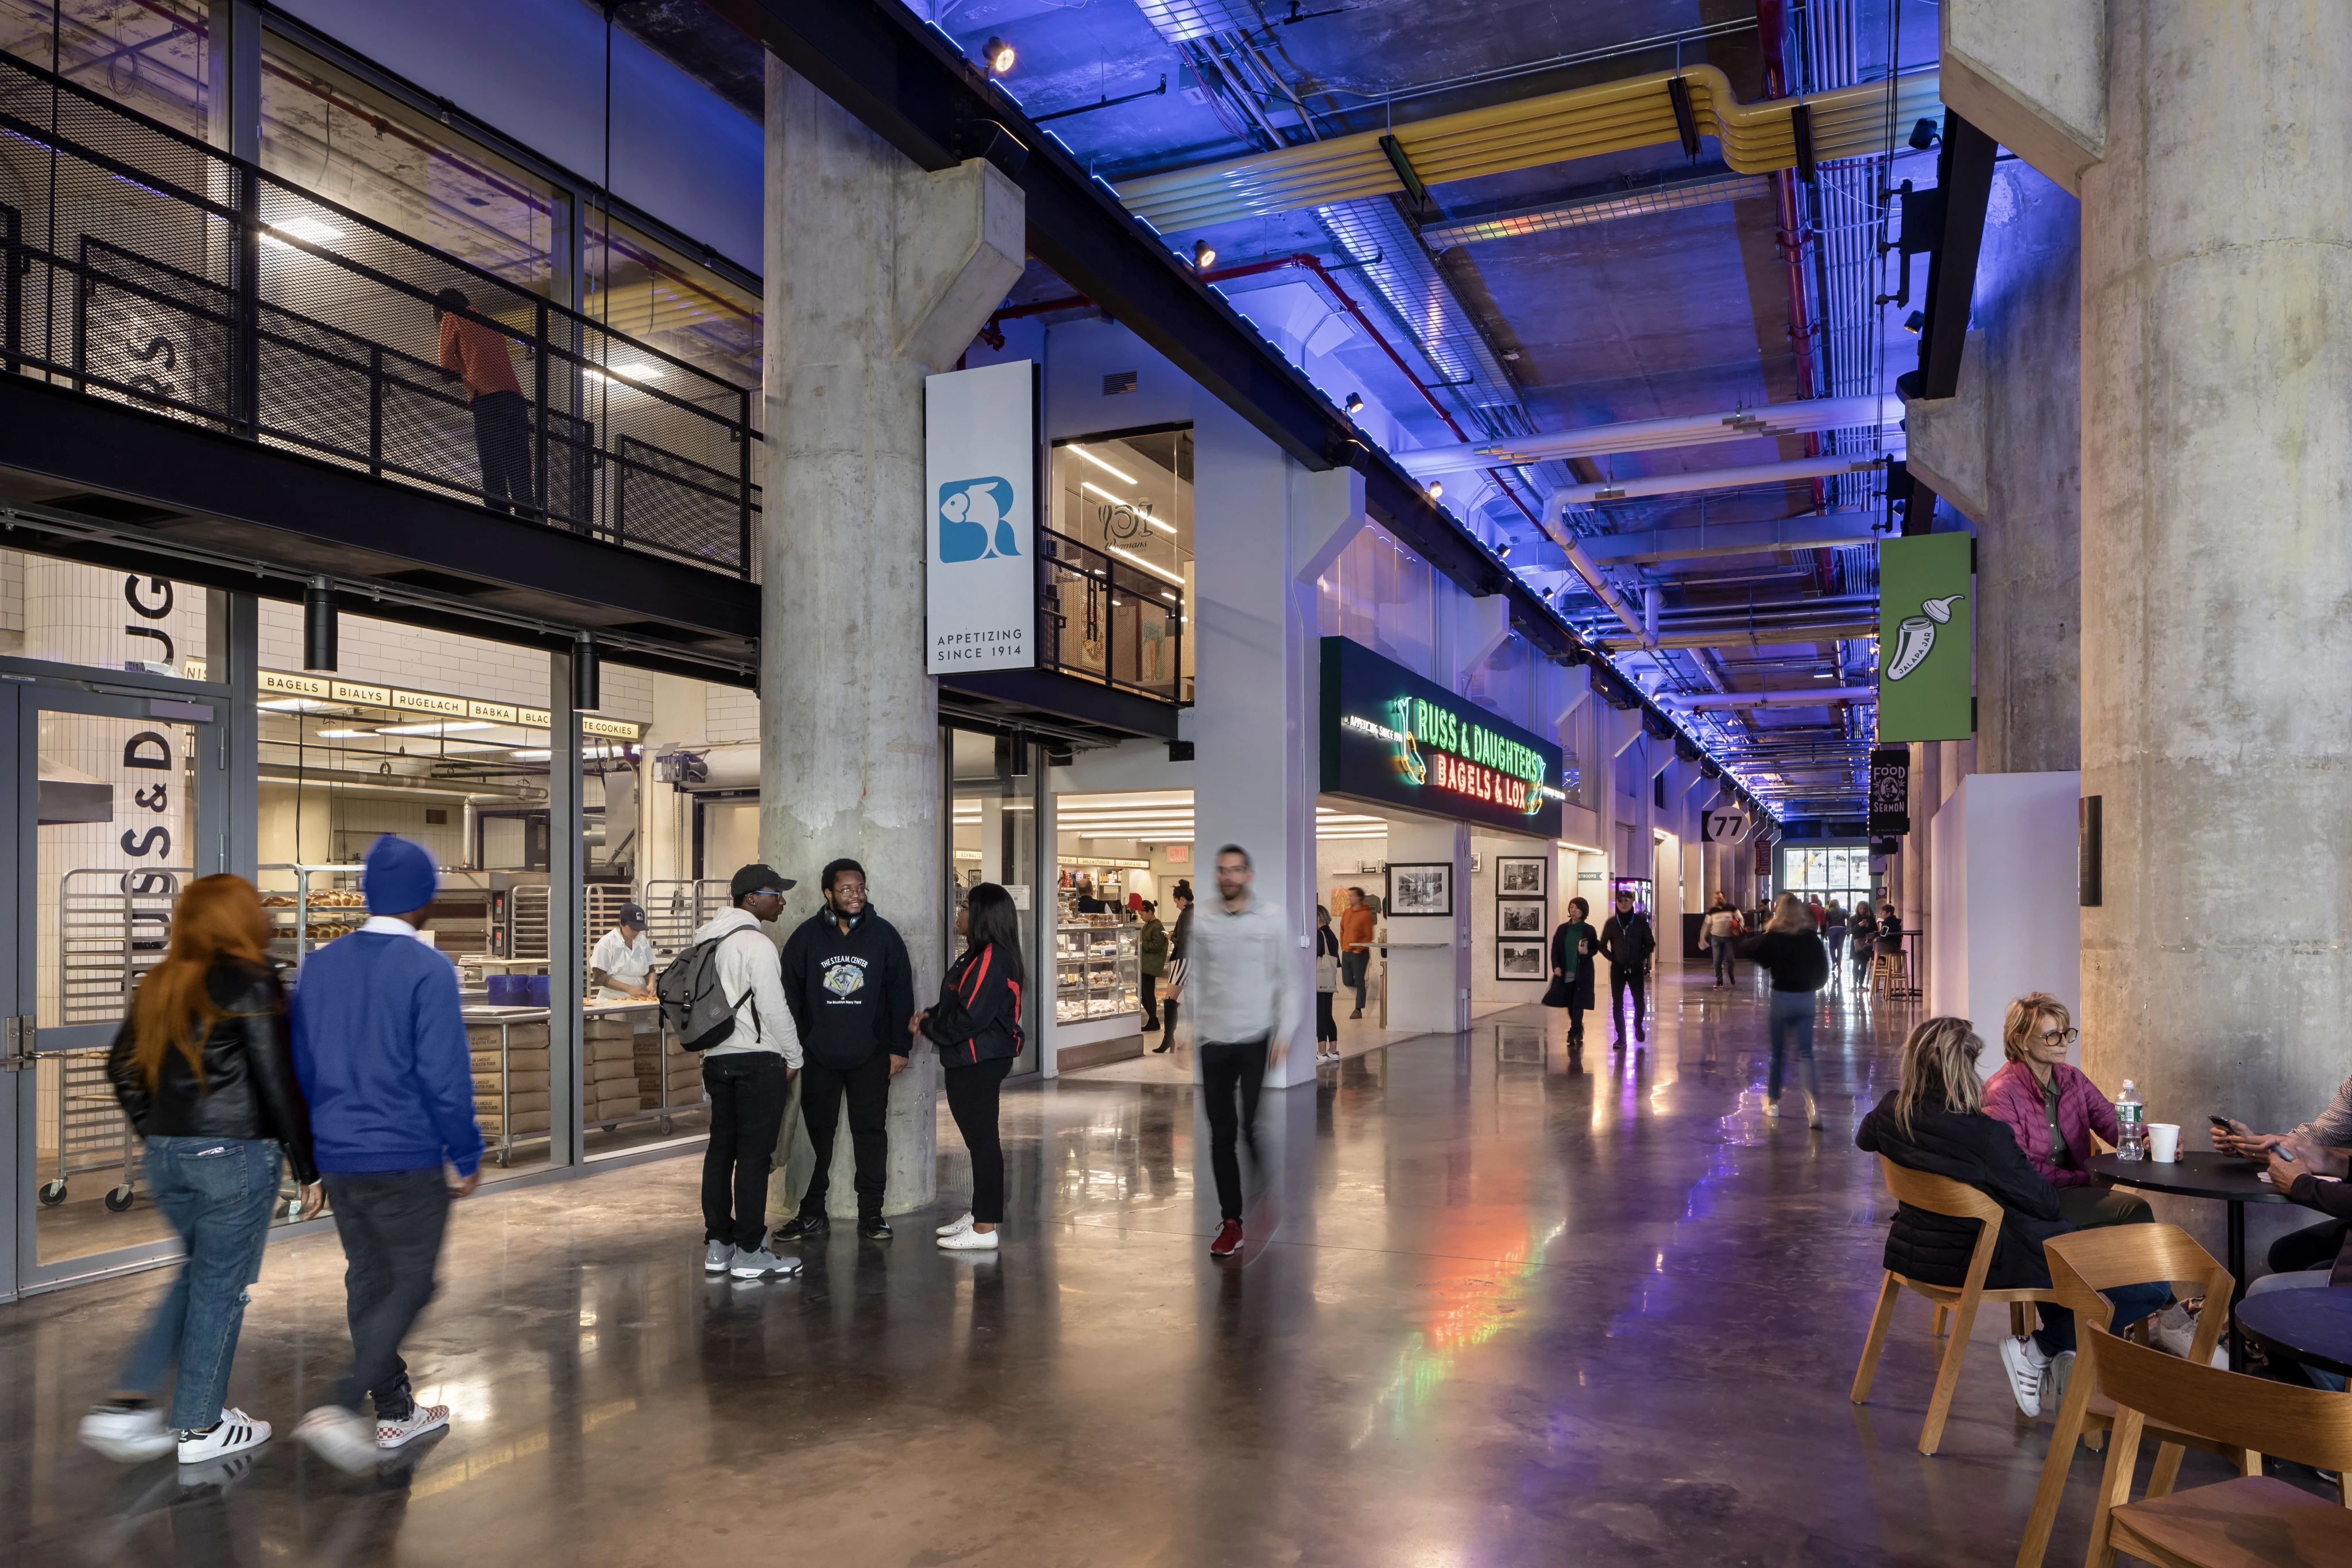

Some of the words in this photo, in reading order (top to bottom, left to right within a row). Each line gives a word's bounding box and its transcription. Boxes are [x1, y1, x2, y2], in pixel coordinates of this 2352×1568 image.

[1103, 538, 1147, 555] Wegmans
[938, 629, 1022, 645] APPETIZING
[938, 648, 981, 660] SINCE
[992, 645, 1021, 656] 1914
[1899, 649, 1924, 673] JALAPA
[1922, 632, 1931, 646] JAR
[268, 677, 318, 692] BAGELS
[340, 688, 382, 701] BIALYS
[400, 696, 458, 711] RUGELACH
[476, 706, 509, 718] BABKA
[596, 723, 632, 735] COOKIES
[1418, 698, 1457, 753] RUSS
[1461, 722, 1470, 758] &
[1474, 724, 1537, 781] DAUGHTERS
[1874, 766, 1905, 780] FOOD
[1438, 754, 1491, 800] BAGELS
[1495, 773, 1503, 803] &
[1506, 777, 1526, 809] LOX
[1874, 801, 1904, 812] SERMON
[1714, 816, 1742, 837] 77
[1169, 848, 1187, 862] EXIT
[821, 959, 831, 969] THE
[851, 957, 868, 969] CENTER
